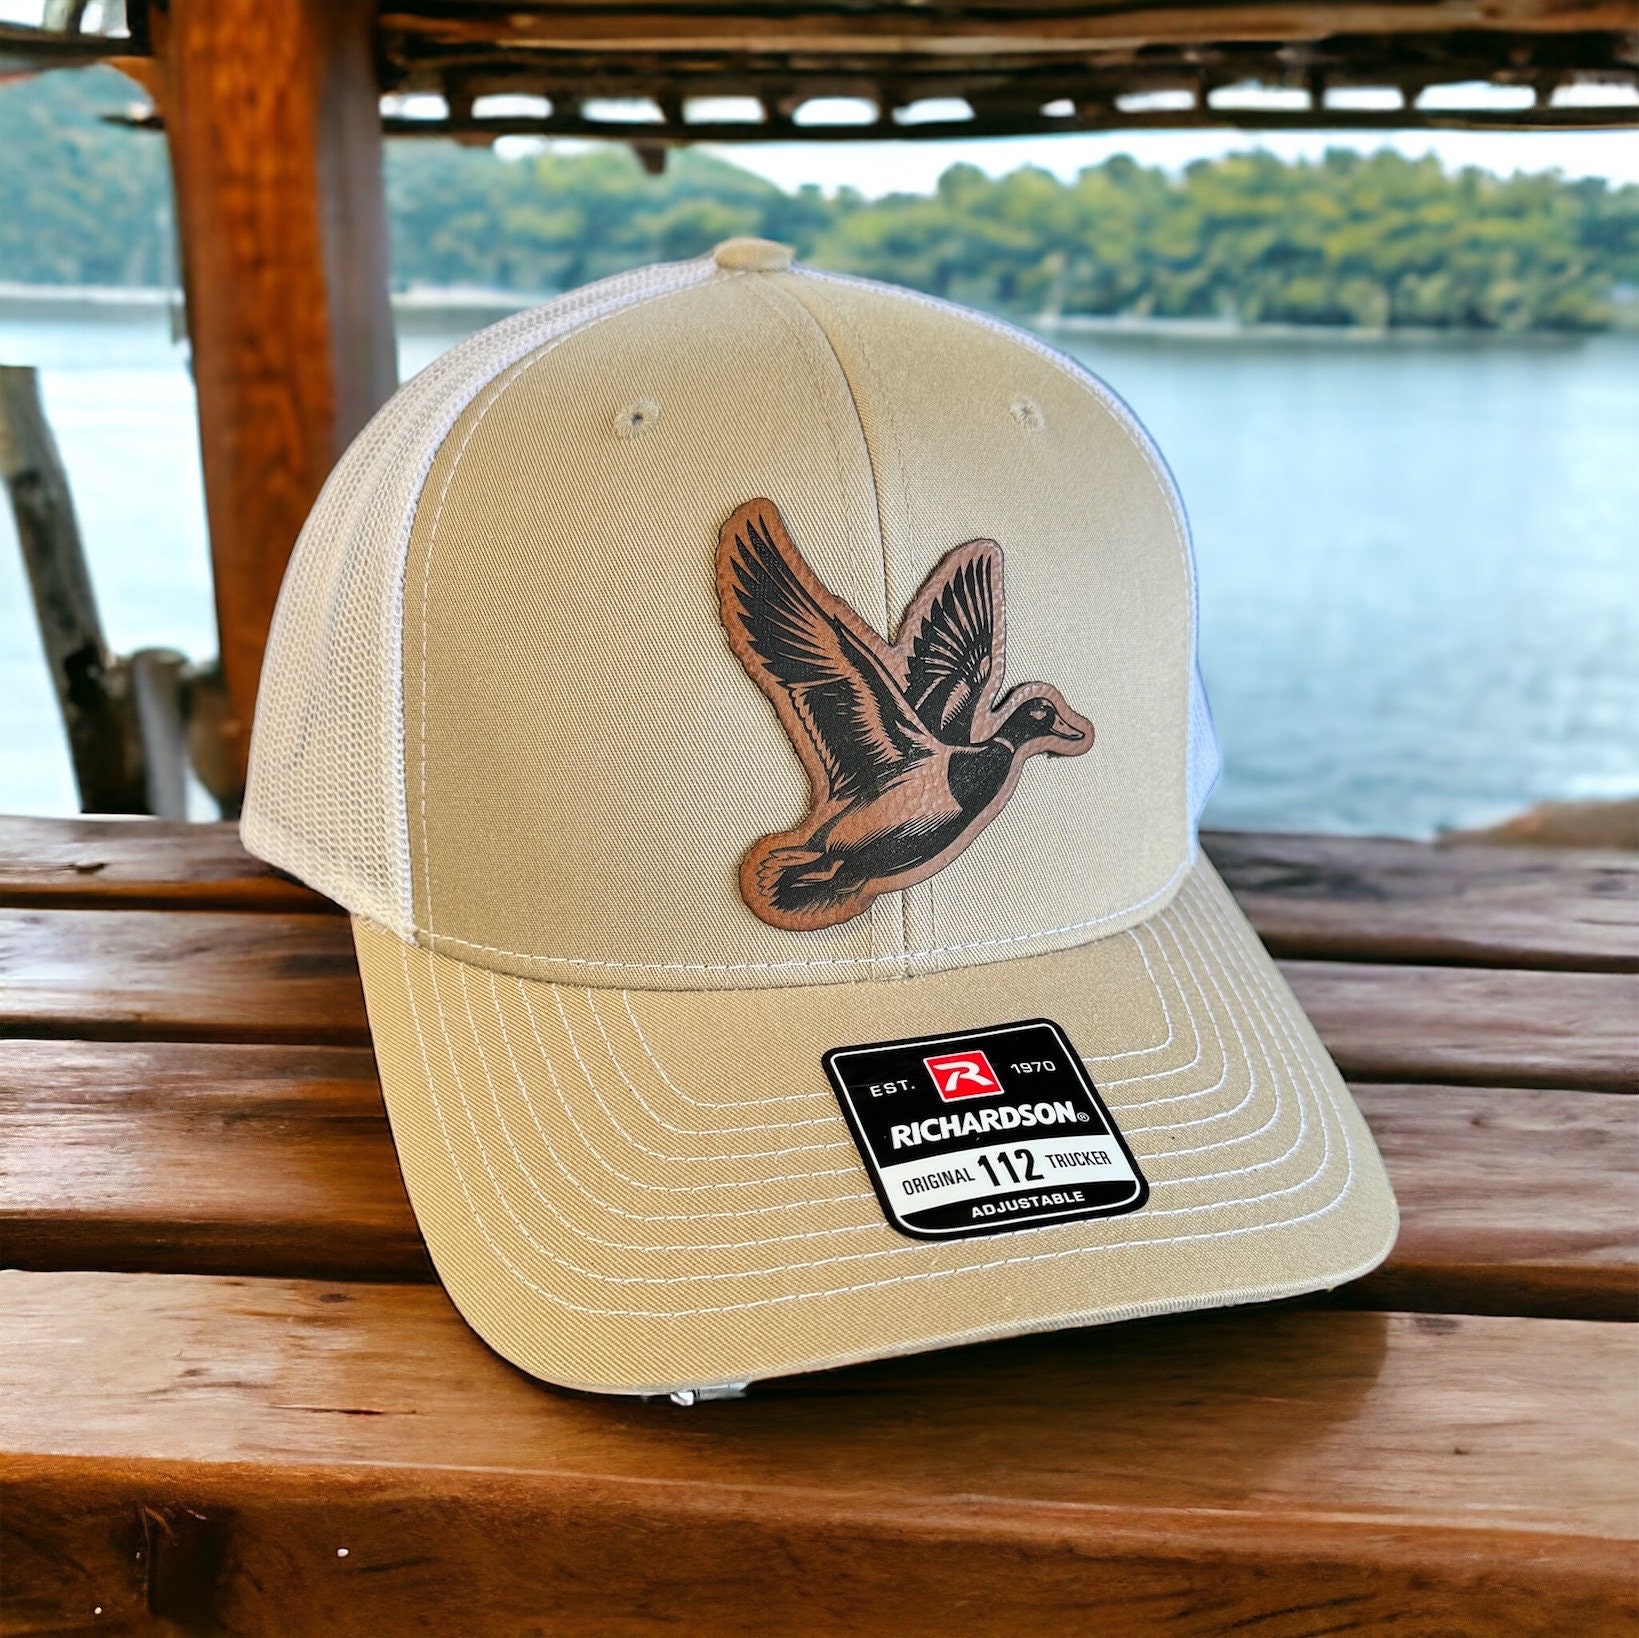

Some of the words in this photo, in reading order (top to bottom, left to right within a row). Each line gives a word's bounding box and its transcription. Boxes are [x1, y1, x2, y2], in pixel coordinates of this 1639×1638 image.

[869, 1078, 916, 1098] EST.
[1010, 1060, 1056, 1075] 1970
[902, 1167, 976, 1196] ORIGINAL
[977, 1148, 1045, 1187] 112
[1045, 1150, 1112, 1170] TRUCKER
[971, 1190, 1085, 1219] ADJUSTABLE
